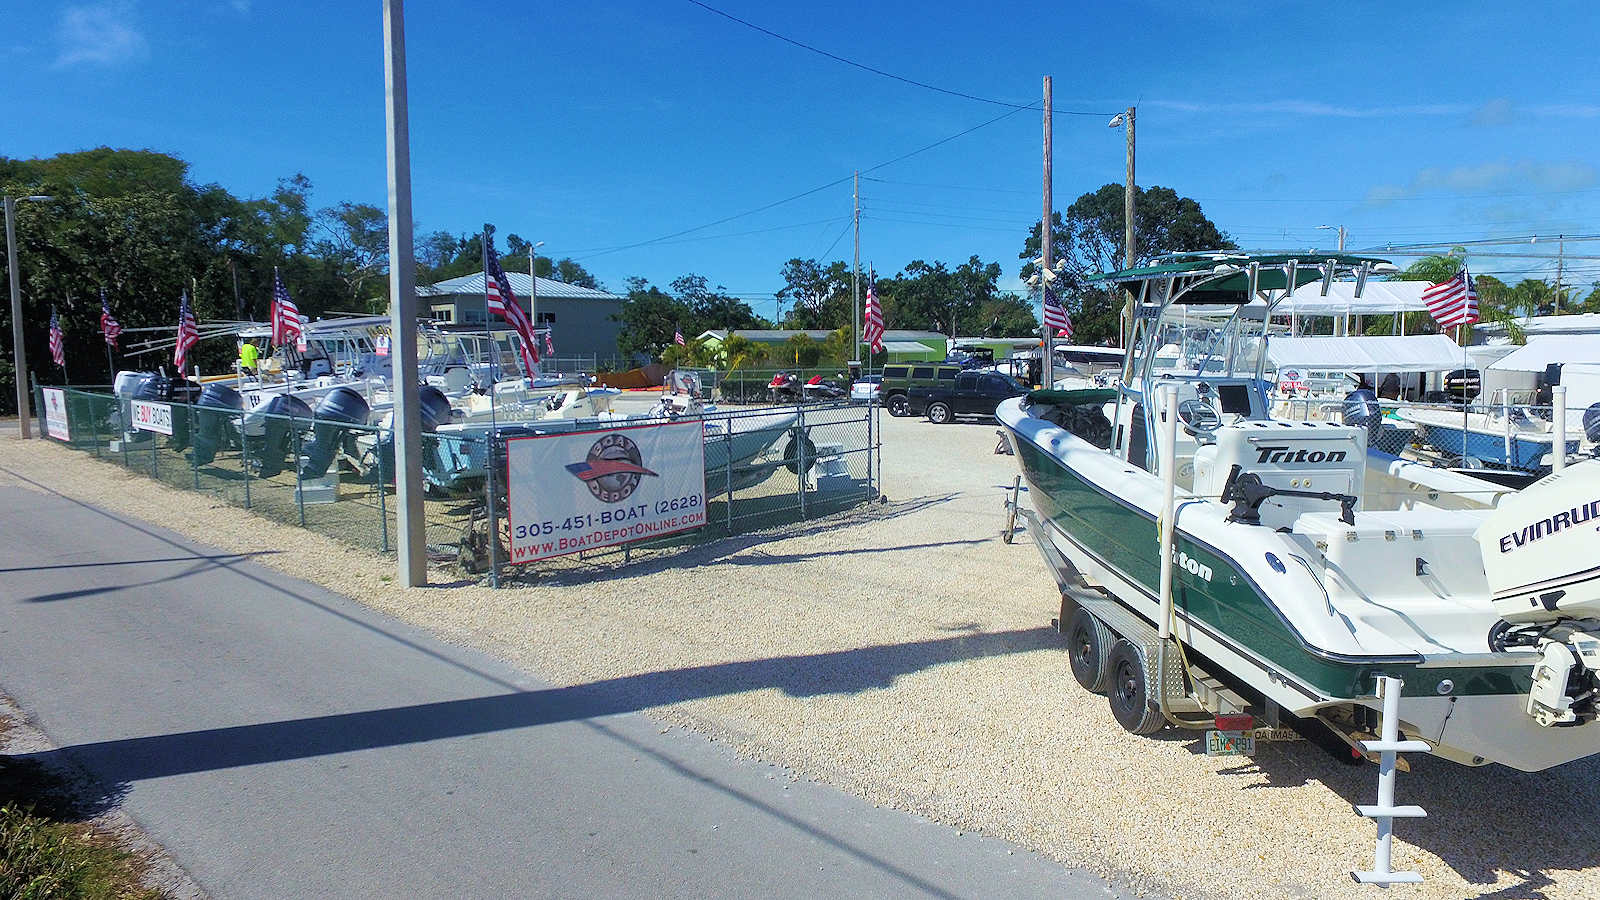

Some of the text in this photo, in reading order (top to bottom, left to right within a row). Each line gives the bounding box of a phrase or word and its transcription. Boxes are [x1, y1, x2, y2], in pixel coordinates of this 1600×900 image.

[141, 404, 151, 423] BUY
[152, 406, 171, 427] BOATS
[590, 435, 635, 457] BOAT
[1256, 446, 1346, 463] Triton
[515, 493, 703, 539] 305-451-BOAT (2628)
